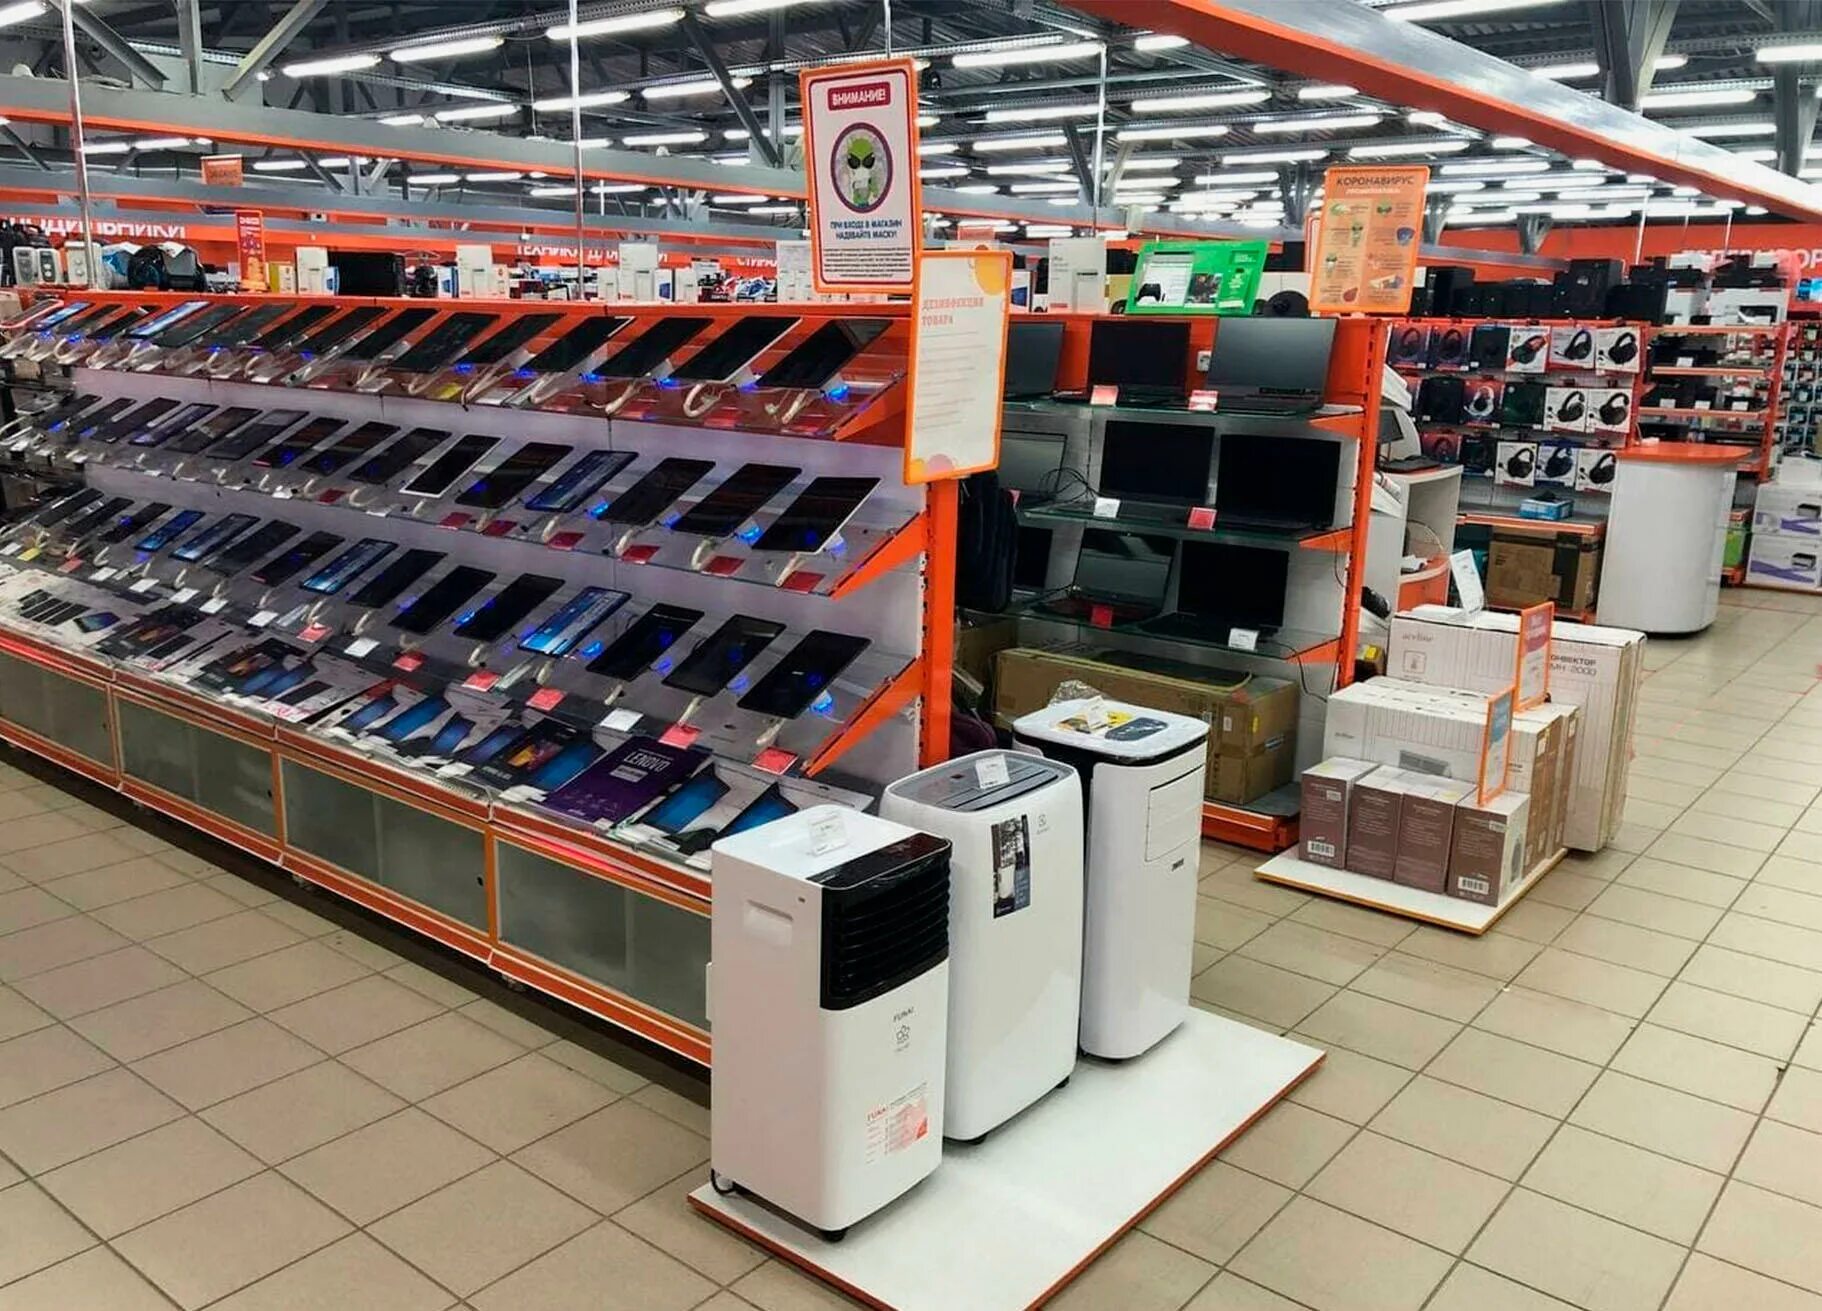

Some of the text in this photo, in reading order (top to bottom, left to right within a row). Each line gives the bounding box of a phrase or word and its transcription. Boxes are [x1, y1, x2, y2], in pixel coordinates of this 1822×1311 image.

[832, 88, 886, 106] ВНИМАНИЕ!
[1336, 175, 1415, 186] КОРОНАВИРУС
[871, 219, 902, 228] МАГАЗИН
[921, 314, 953, 327] ТОВАРА
[1550, 654, 1597, 667] ОНВЕКТОР
[623, 751, 671, 773] LENOVO
